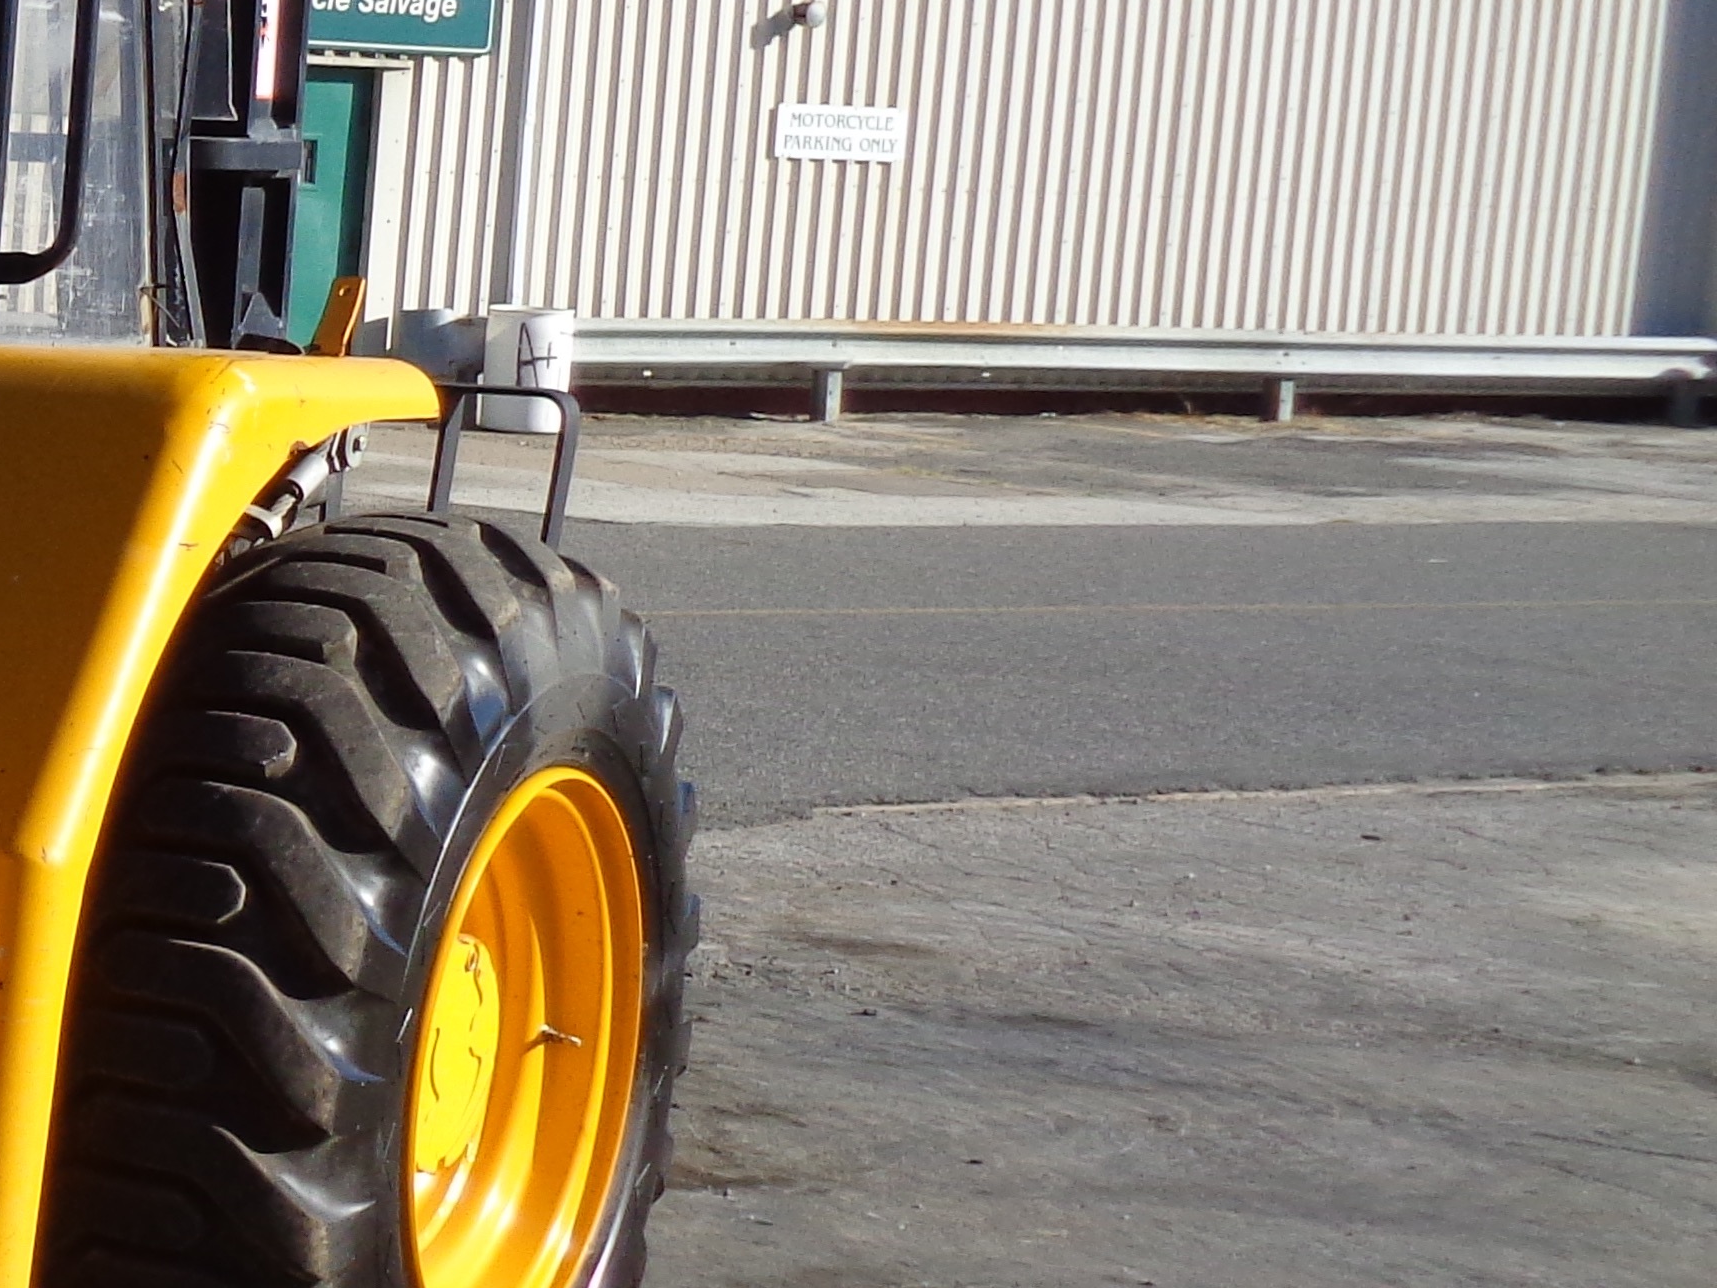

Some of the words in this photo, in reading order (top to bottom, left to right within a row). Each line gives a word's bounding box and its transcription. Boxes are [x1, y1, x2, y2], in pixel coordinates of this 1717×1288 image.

[789, 112, 895, 132] MOTORCYCLE
[783, 134, 853, 152] PARKING
[859, 137, 898, 153] ONLY
